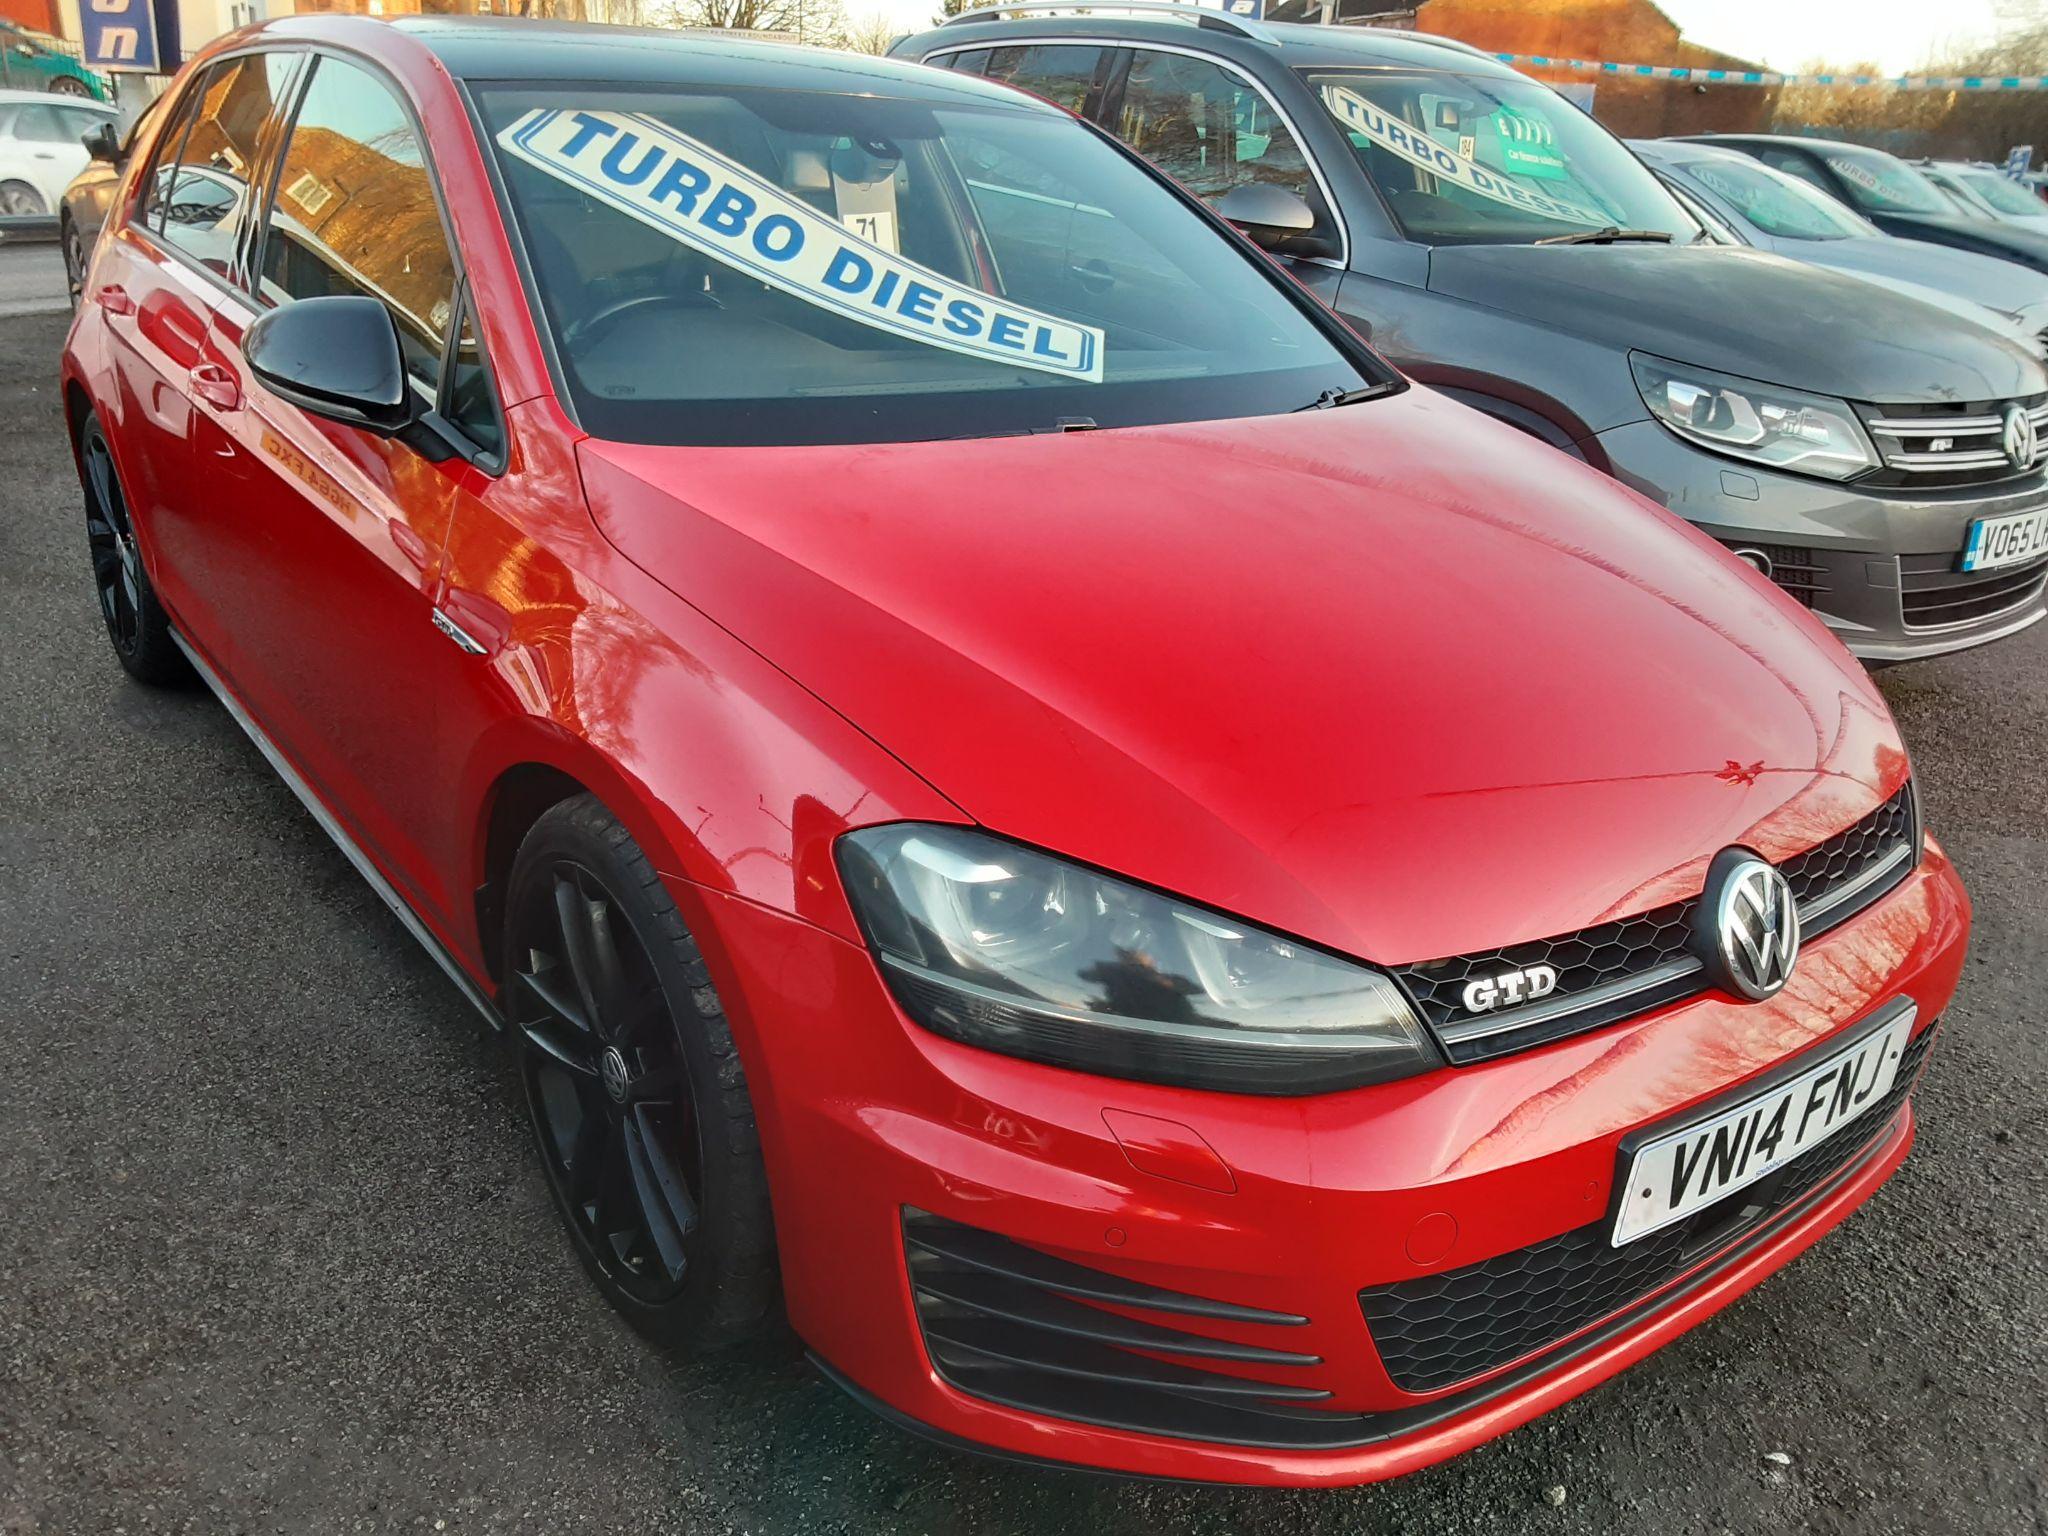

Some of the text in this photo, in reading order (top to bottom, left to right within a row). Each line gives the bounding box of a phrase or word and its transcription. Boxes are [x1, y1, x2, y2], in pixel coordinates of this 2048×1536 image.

[1339, 95, 1602, 222] TURBO DIESEL
[1834, 159, 1876, 188] TURBO
[560, 112, 1069, 361] TURBO DIESEL
[856, 217, 877, 243] 71
[1983, 519, 2034, 560] VO65
[1463, 966, 1556, 1013] GTD
[1669, 1033, 1892, 1210] VN14 FNJ
